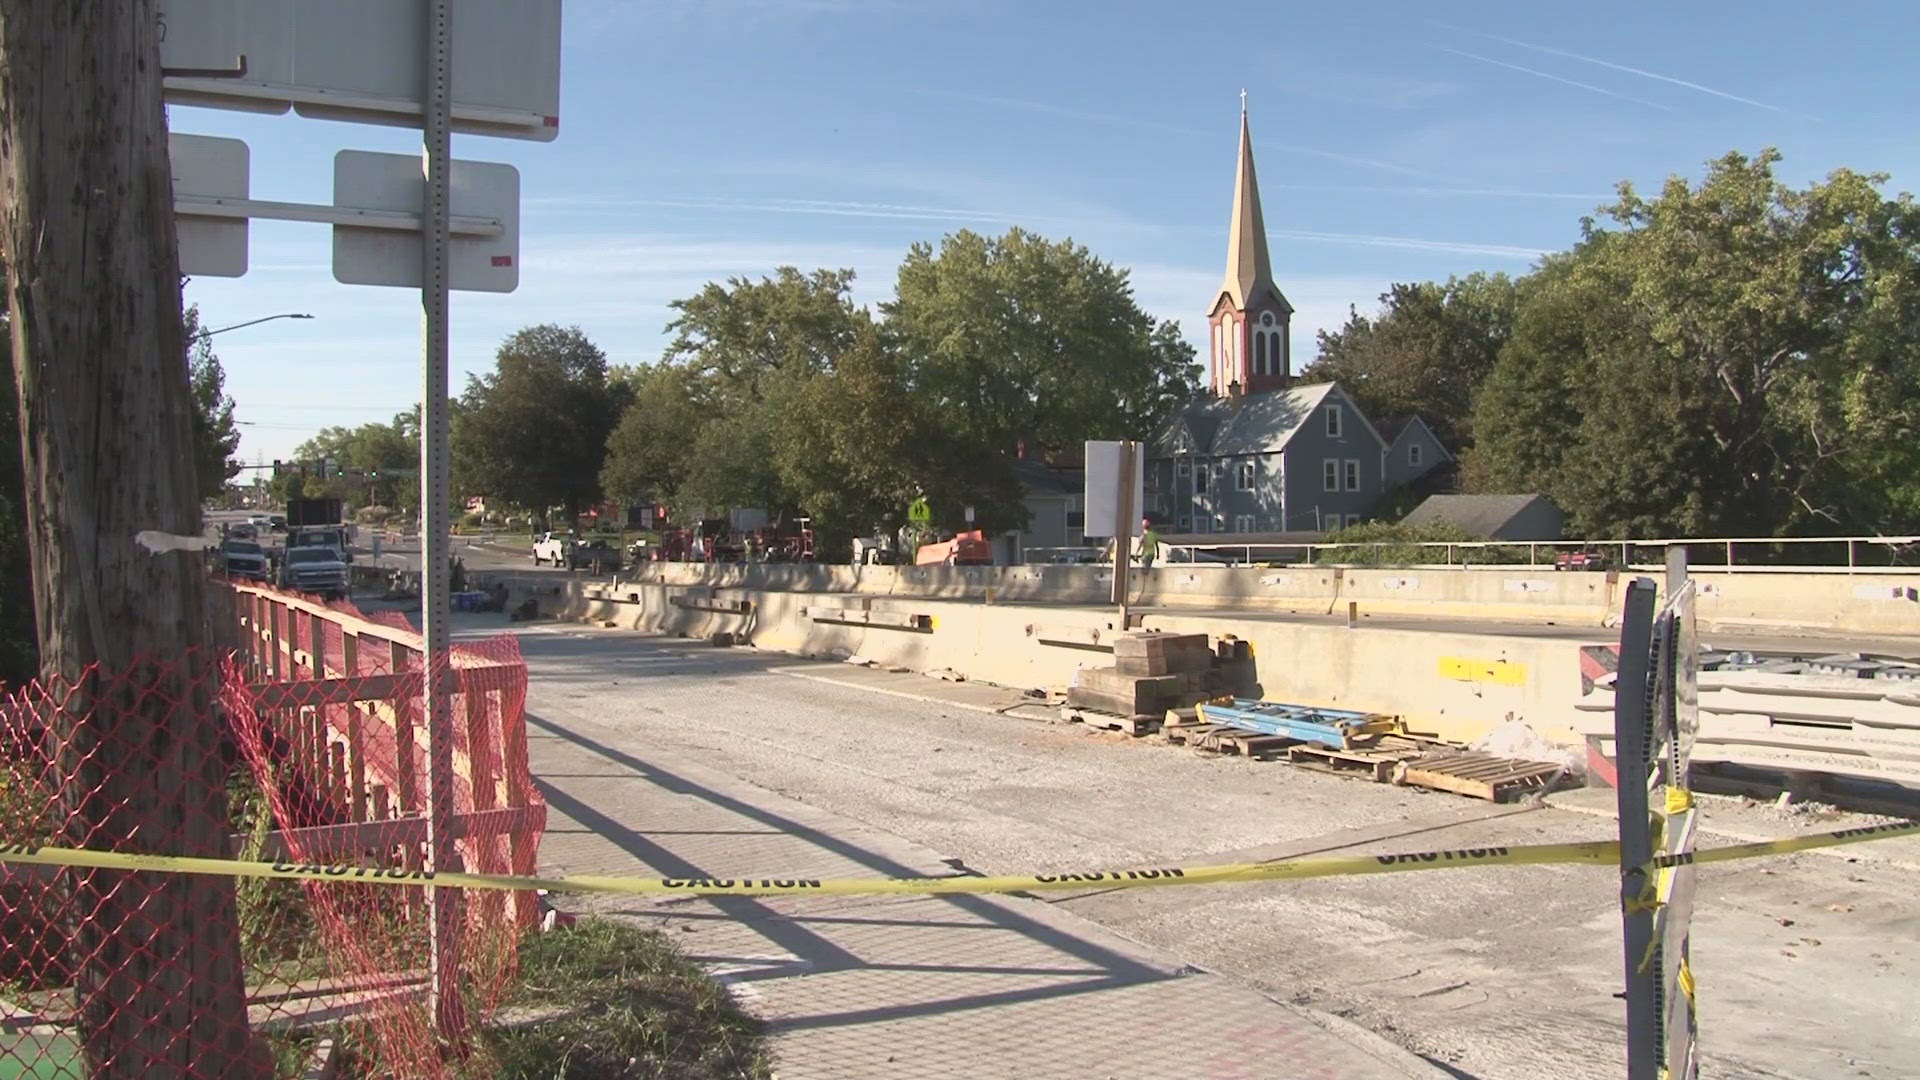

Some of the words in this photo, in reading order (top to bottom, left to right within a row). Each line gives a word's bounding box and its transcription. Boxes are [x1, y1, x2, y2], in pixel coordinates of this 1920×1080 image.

[271, 863, 438, 880] CAUTION
[1034, 868, 1185, 883] CAUTION
[661, 878, 823, 889] CAUTION
